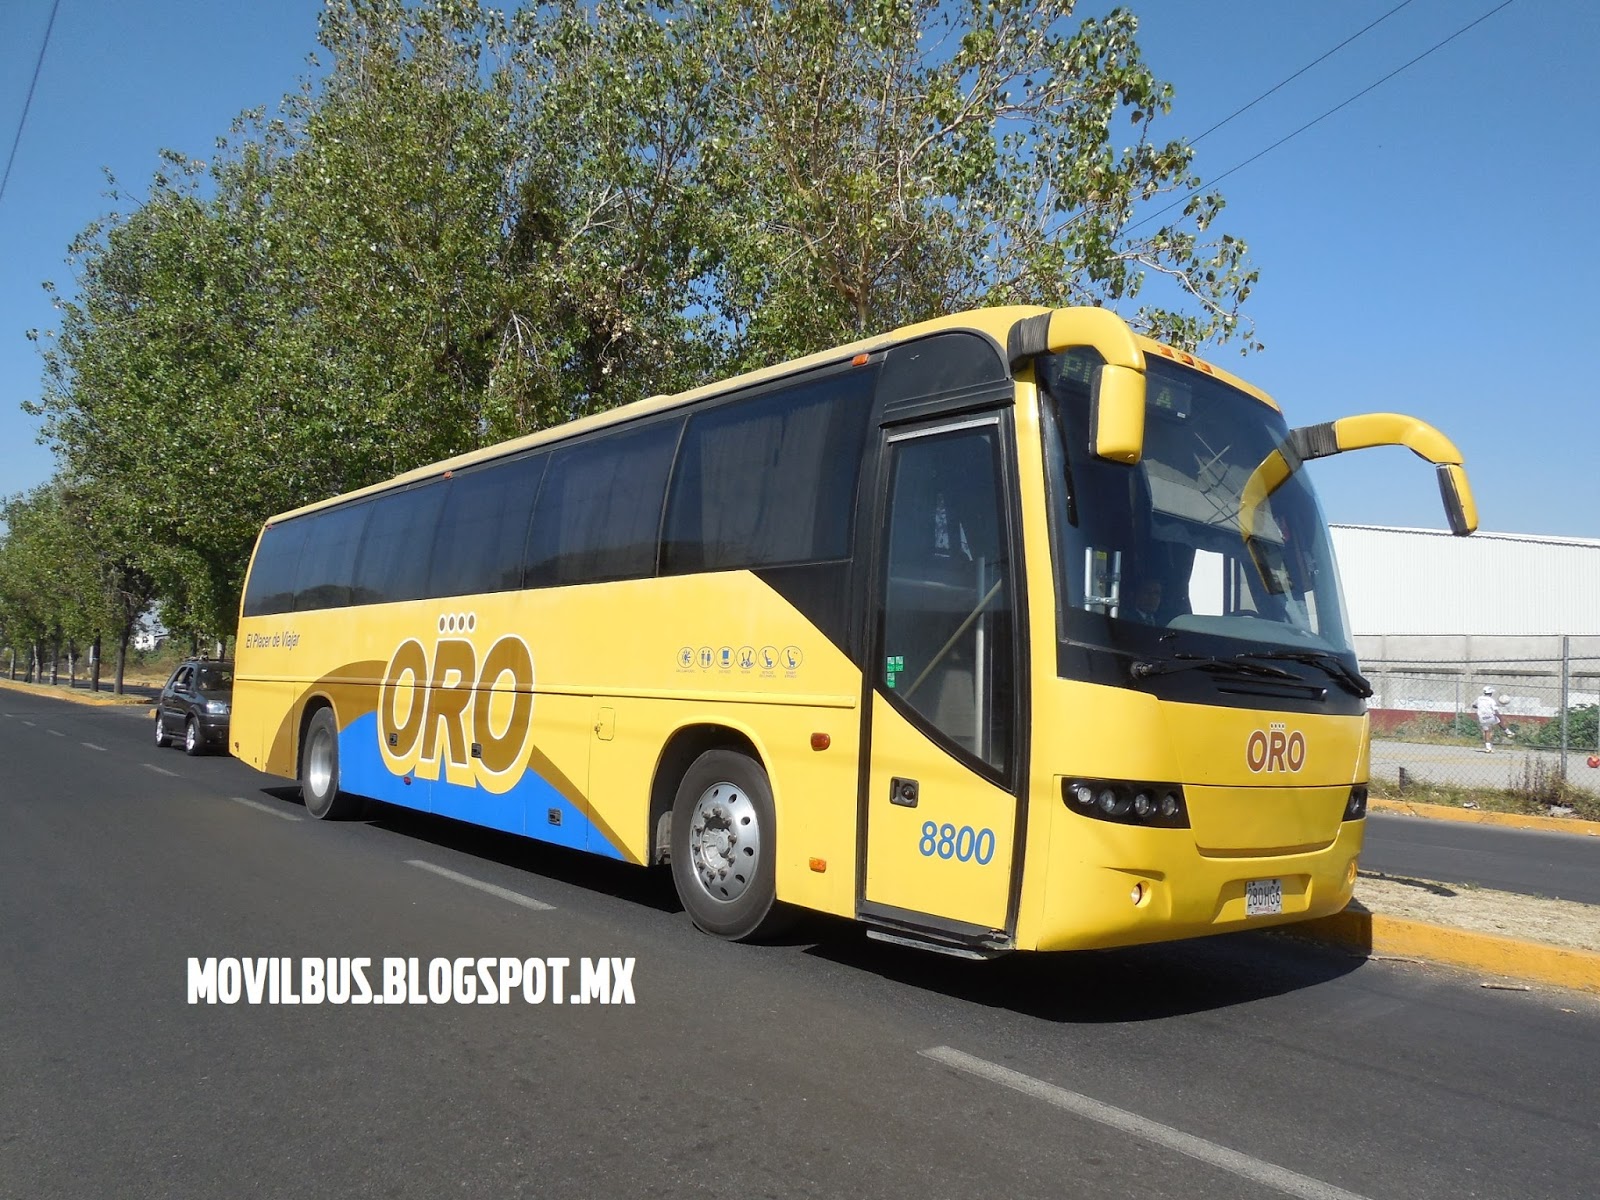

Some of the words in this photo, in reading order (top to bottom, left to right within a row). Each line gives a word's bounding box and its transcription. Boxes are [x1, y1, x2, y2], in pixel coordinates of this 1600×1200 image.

[246, 633, 253, 648] El
[253, 632, 271, 648] Placer
[271, 632, 281, 647] de
[282, 631, 301, 651] Viajar
[378, 633, 535, 778] ORO
[1246, 729, 1306, 773] ORO
[918, 820, 996, 865] 8800
